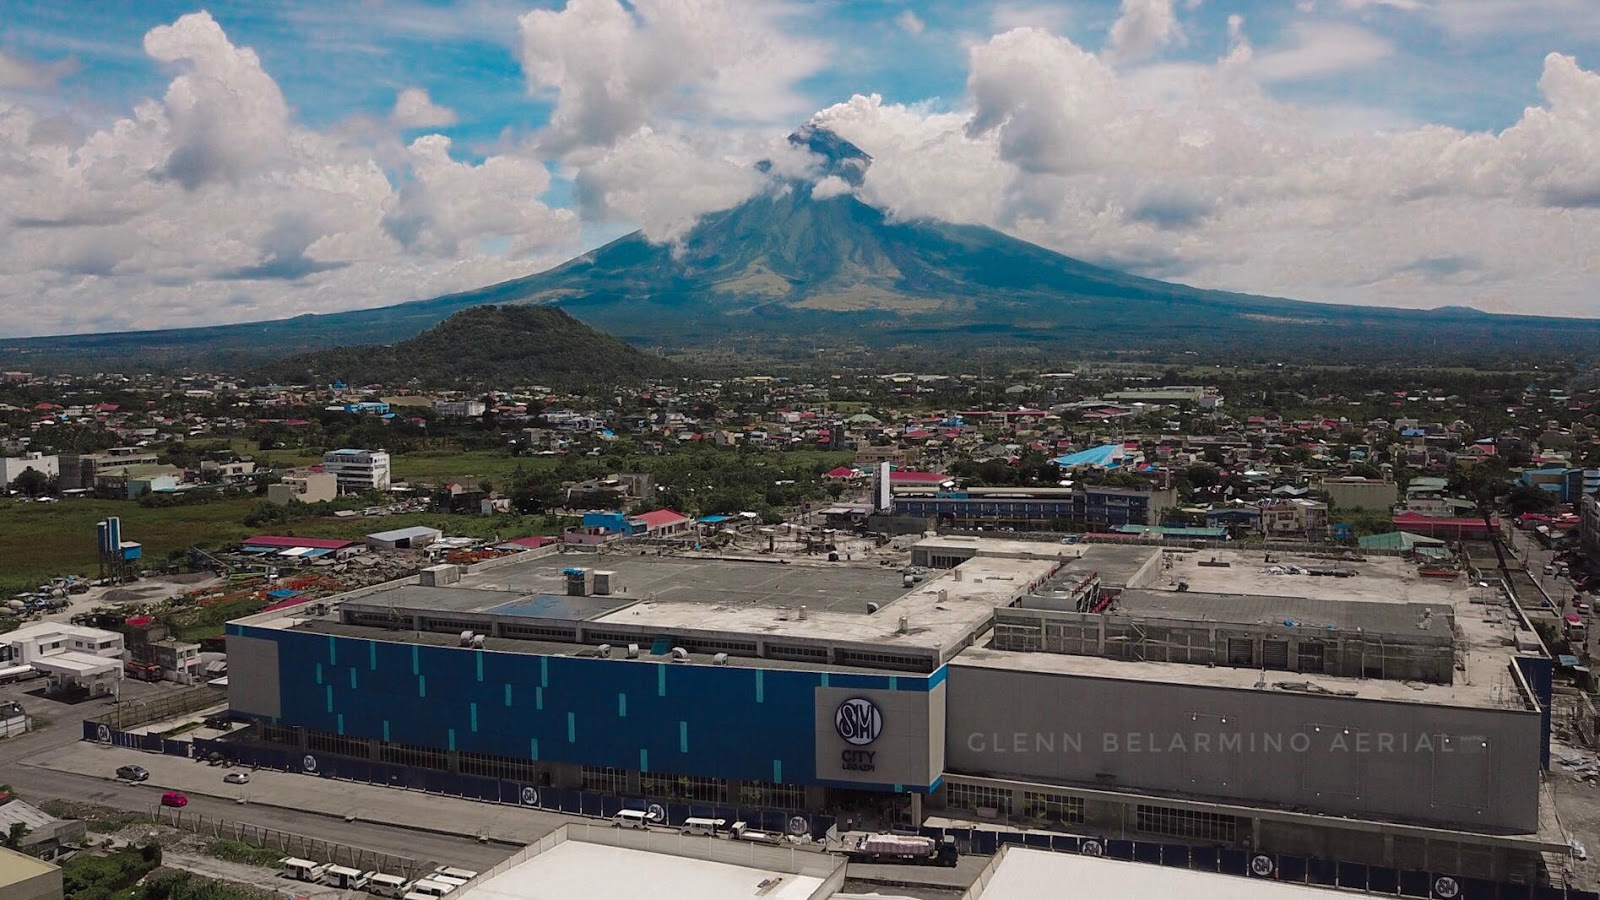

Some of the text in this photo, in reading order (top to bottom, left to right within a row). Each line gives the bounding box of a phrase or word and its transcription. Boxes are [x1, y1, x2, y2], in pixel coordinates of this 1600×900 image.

[839, 702, 876, 740] SM
[841, 750, 876, 763] CITY
[1253, 857, 1271, 874] SM
[1437, 879, 1456, 896] SM
